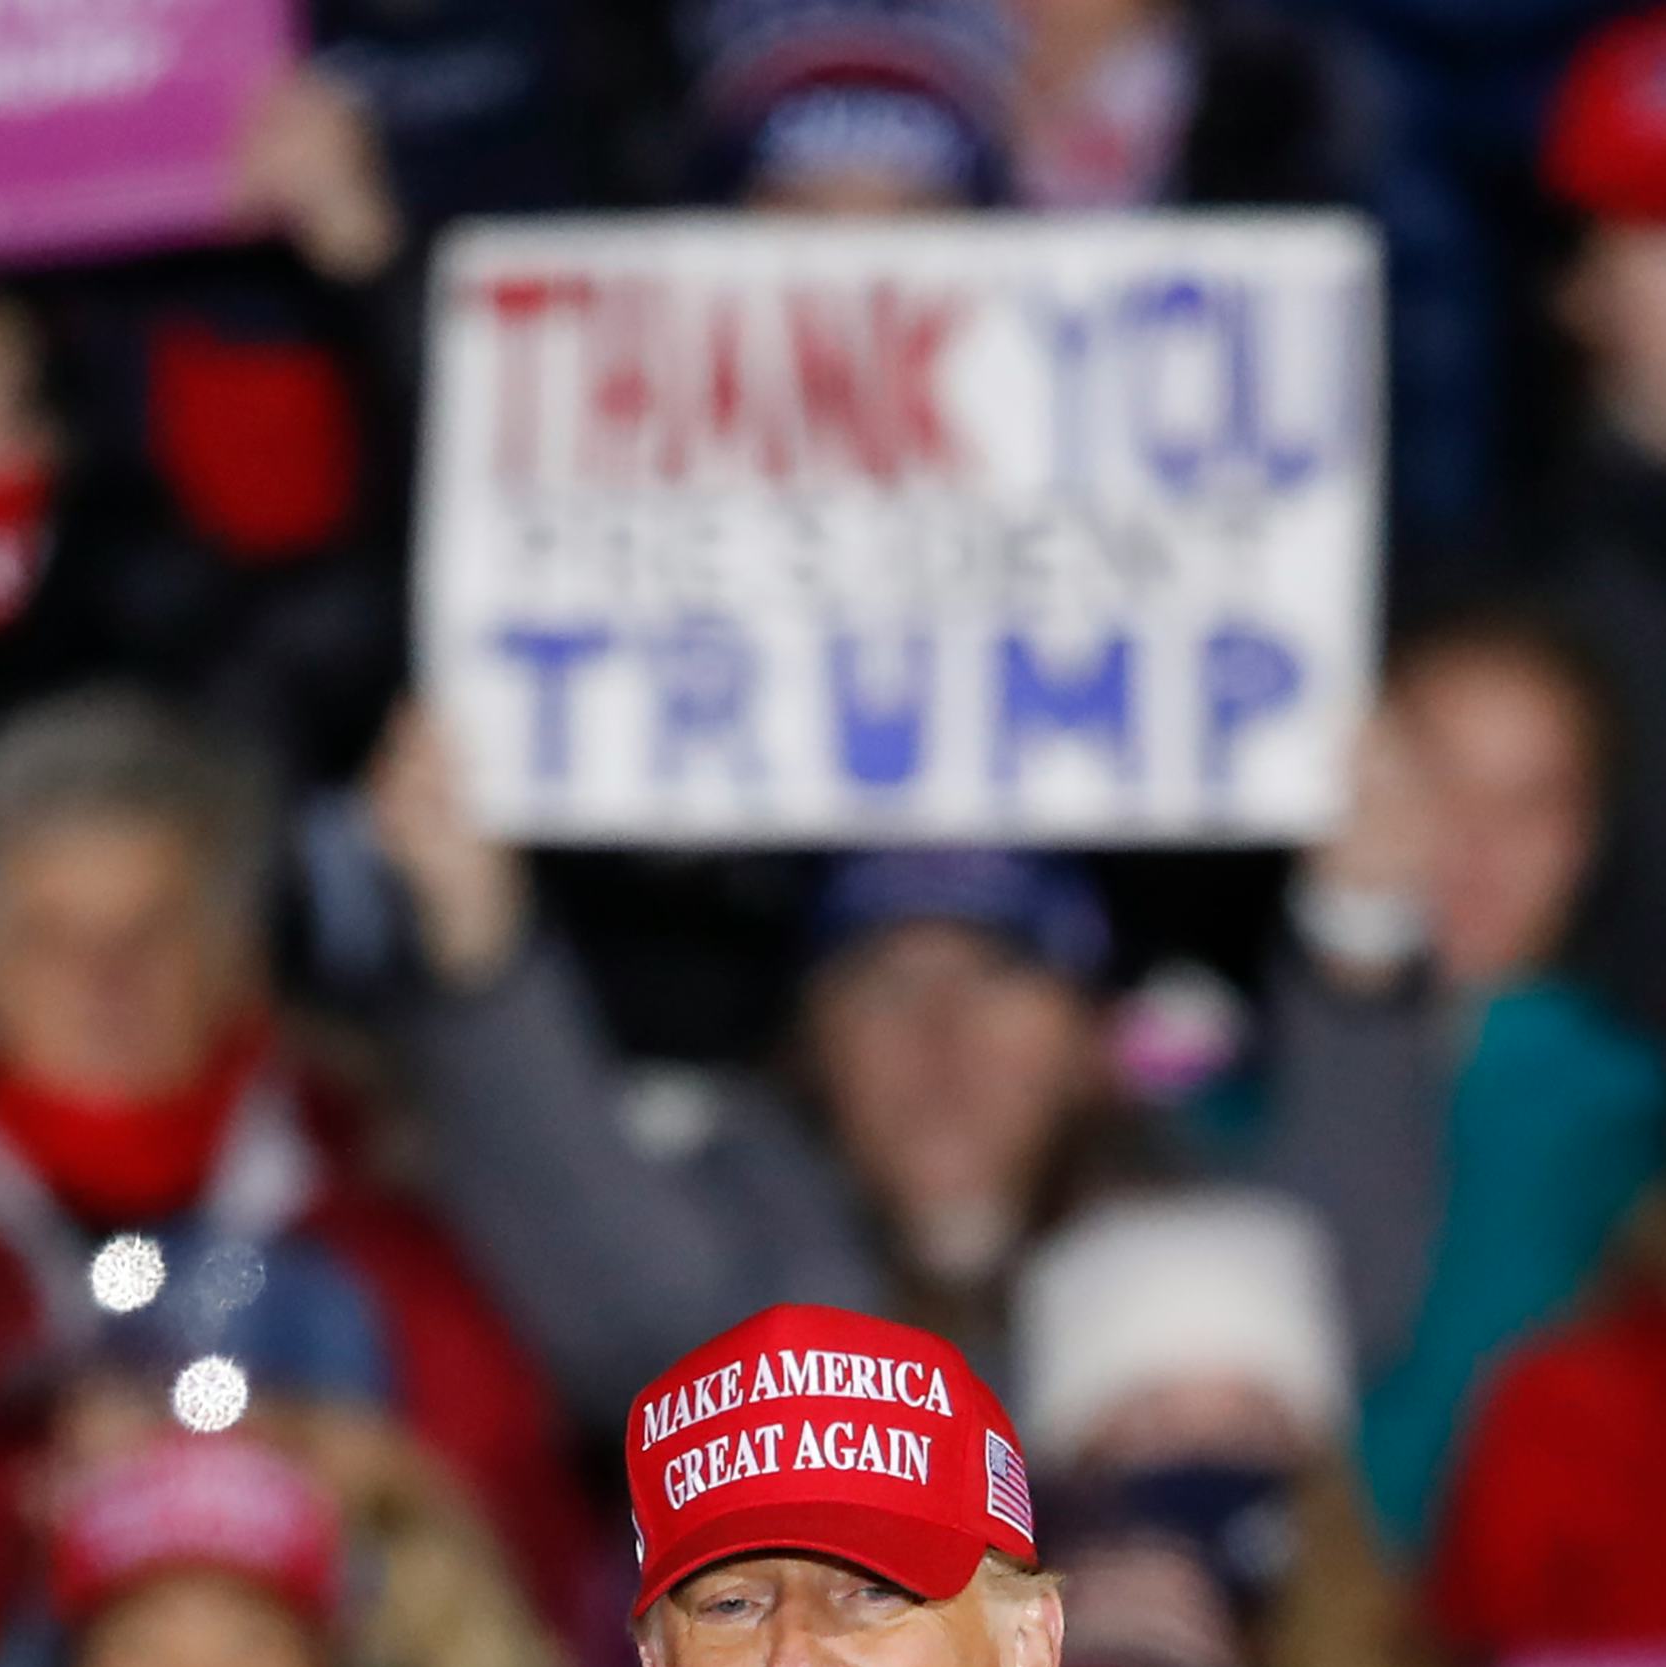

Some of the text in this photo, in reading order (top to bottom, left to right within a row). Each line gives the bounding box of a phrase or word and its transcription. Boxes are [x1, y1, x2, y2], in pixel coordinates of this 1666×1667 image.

[478, 270, 975, 492] THANK
[493, 618, 1313, 800] TRUMP
[641, 1349, 954, 1452] MAKE AMERICA
[664, 1420, 932, 1511] GREAT AGAIN
